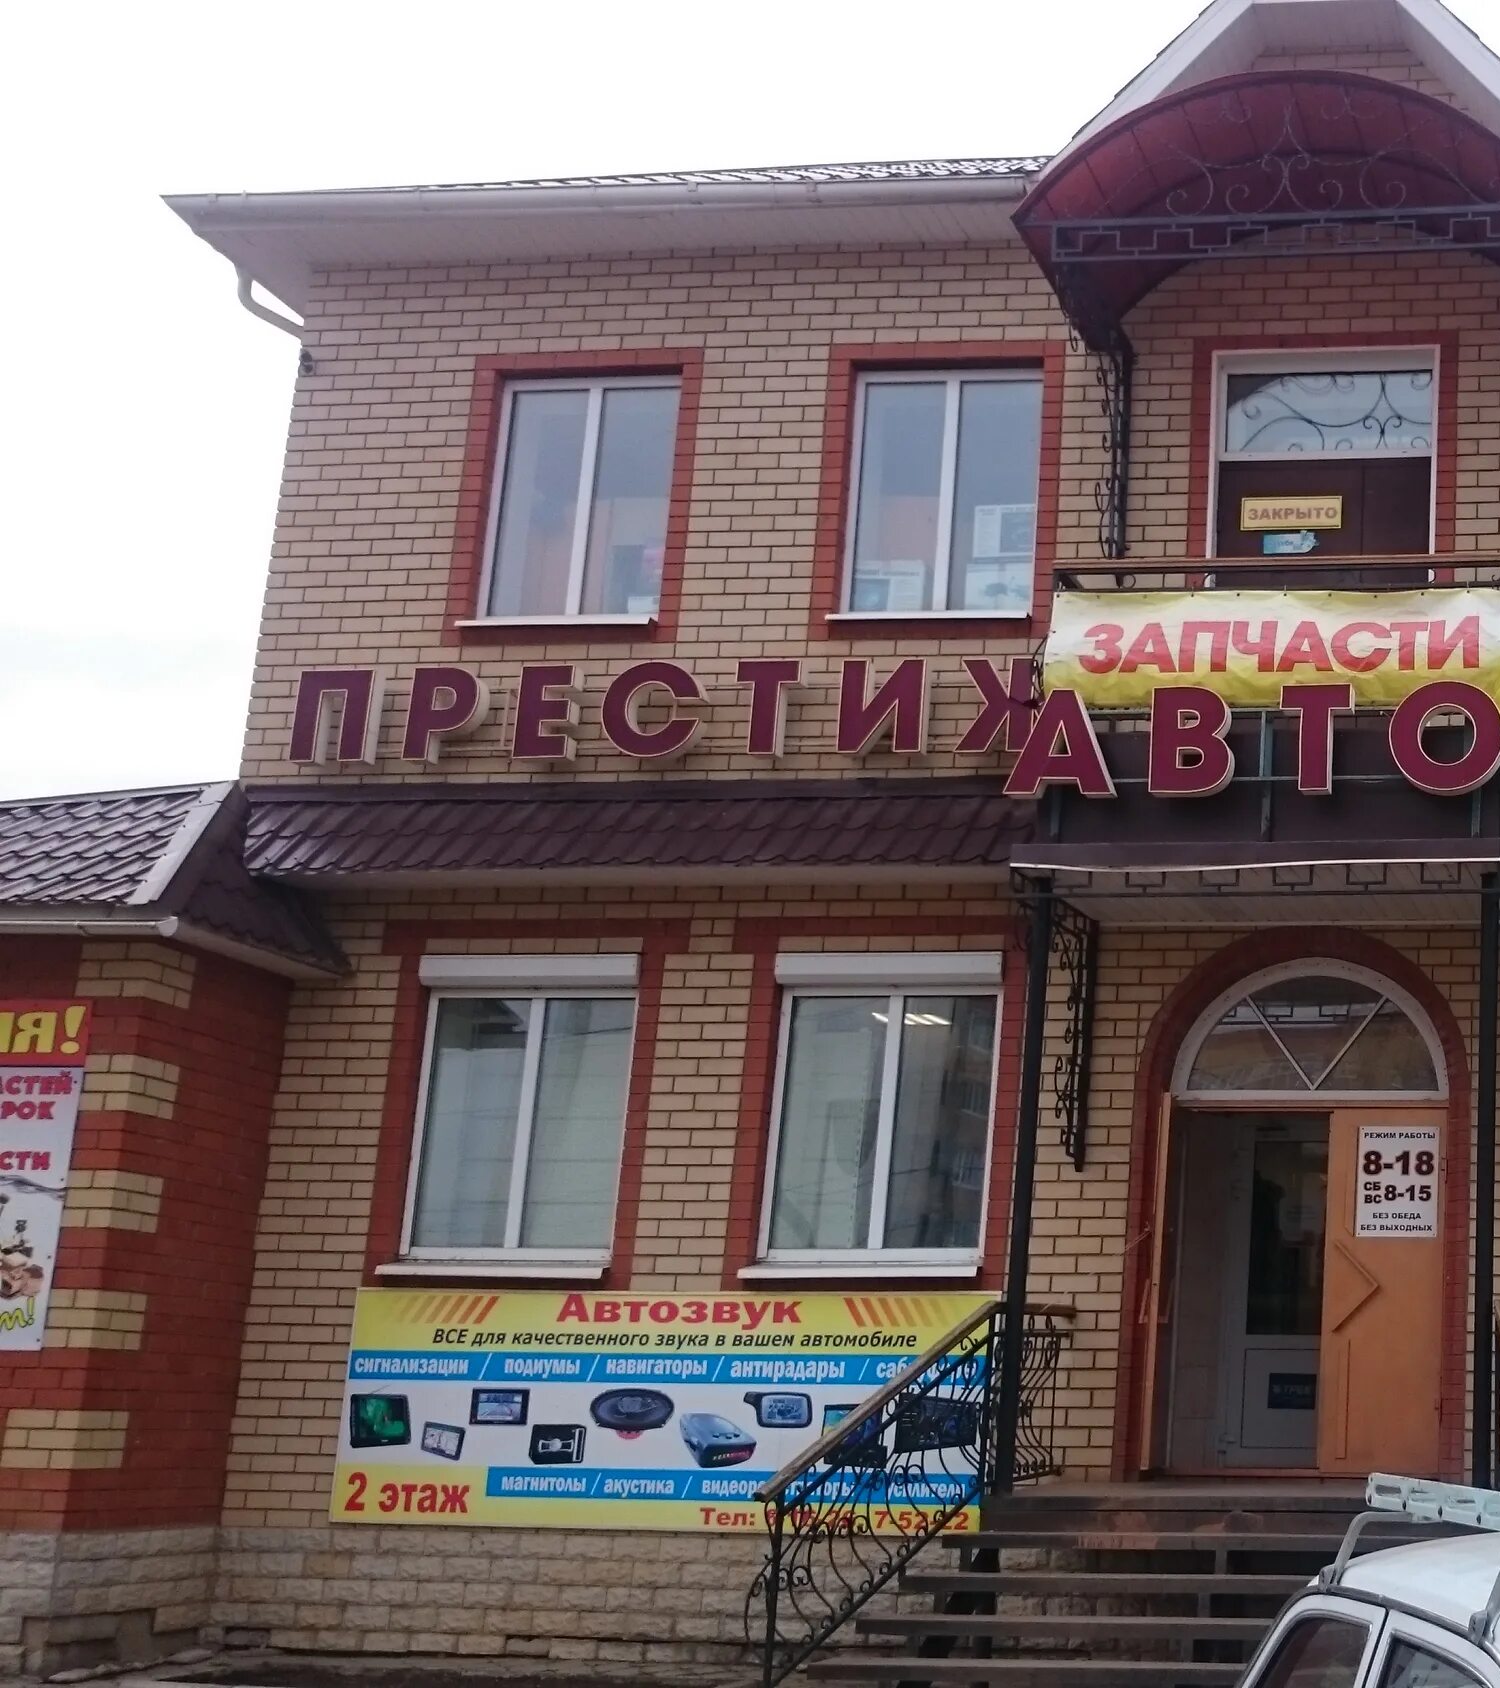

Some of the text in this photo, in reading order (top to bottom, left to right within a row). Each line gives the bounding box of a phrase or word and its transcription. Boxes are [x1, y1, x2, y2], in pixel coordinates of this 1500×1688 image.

[1247, 507, 1338, 521] ЗАКРЫТО
[1078, 615, 1480, 674] ЗАПЧАСТИ
[289, 659, 1041, 765] ПРЕСТИЖ
[1362, 1150, 1435, 1176] 8-18
[1363, 1181, 1382, 1191] СБ
[1384, 1184, 1432, 1202] 8-15
[1364, 1194, 1382, 1204] ВС
[1392, 1212, 1421, 1220] ОБЕДА
[1379, 1224, 1433, 1232] ВЫХОДНЫХ
[556, 1293, 804, 1330] Автозвук
[431, 1328, 917, 1350] ВСЕ для качественного звука в вашем автомобиле
[354, 1357, 469, 1376] сигнализации
[503, 1357, 581, 1377] подиумы
[606, 1358, 708, 1378] навигаторы
[730, 1359, 846, 1382] антирадары
[344, 1471, 471, 1515] 2 этаж
[501, 1474, 586, 1493] магнитолы
[603, 1477, 675, 1496] акустика
[700, 1507, 756, 1527] Тел:
